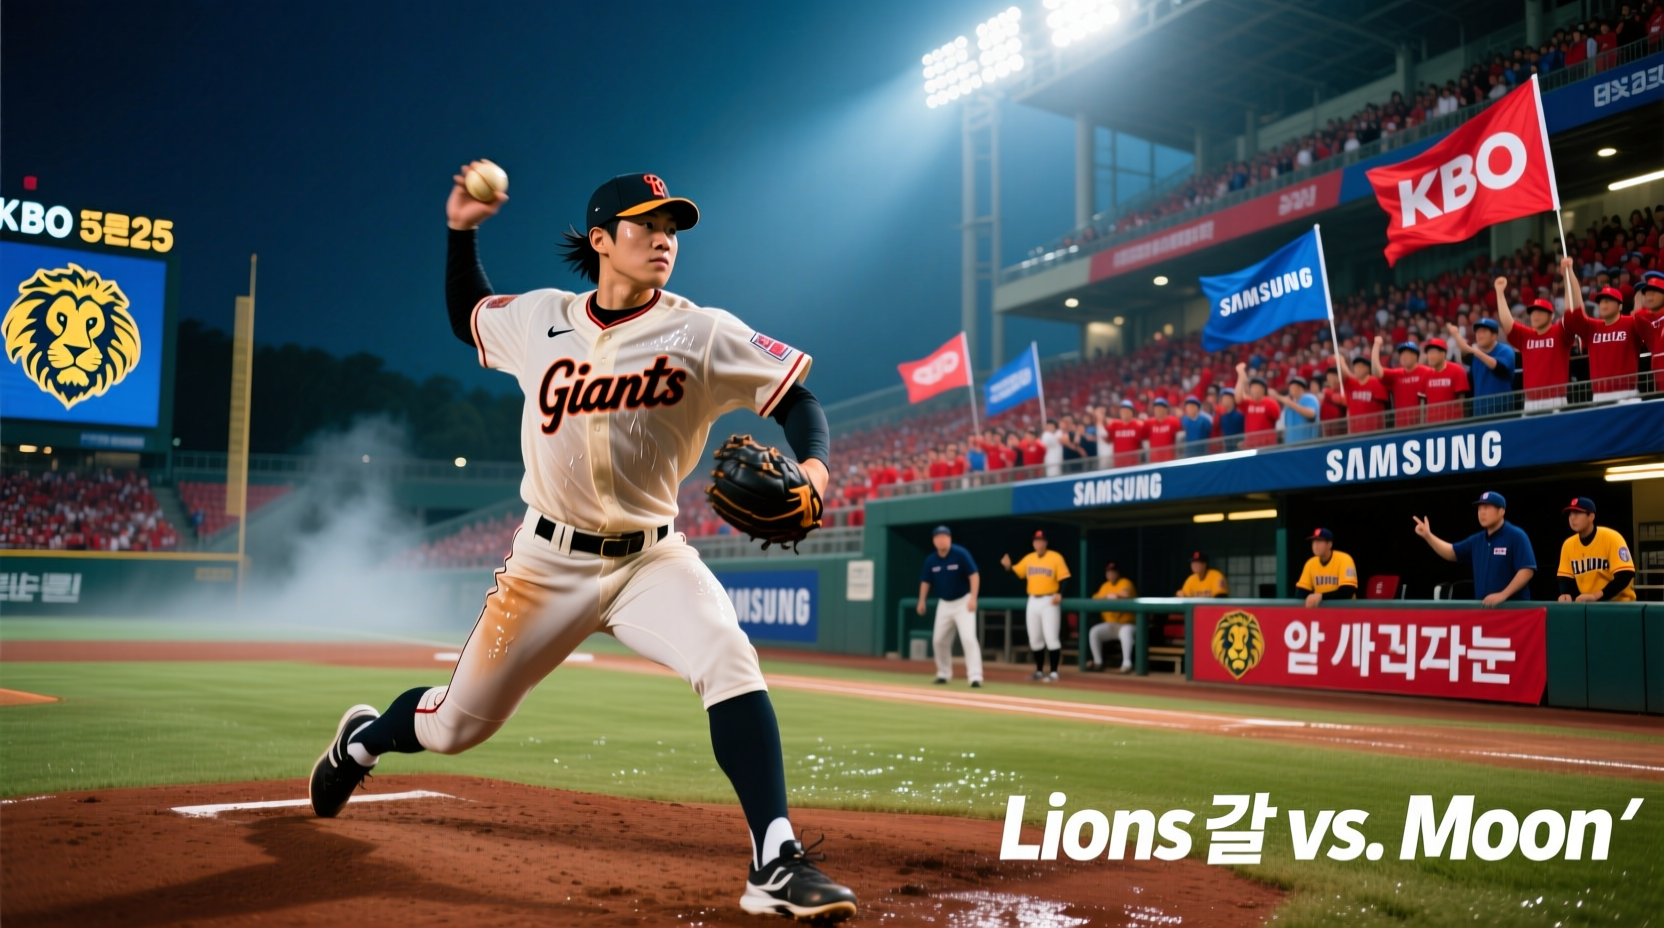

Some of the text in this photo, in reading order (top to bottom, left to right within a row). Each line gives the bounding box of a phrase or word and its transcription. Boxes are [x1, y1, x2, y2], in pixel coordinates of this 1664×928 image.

[1398, 132, 1527, 228] KBO
[0, 196, 74, 239] KBO
[1219, 267, 1313, 317] SAMSUNG
[539, 355, 687, 435] Giants
[1326, 431, 1502, 482] SAMSUNG
[1073, 473, 1162, 506] SAMSUNG
